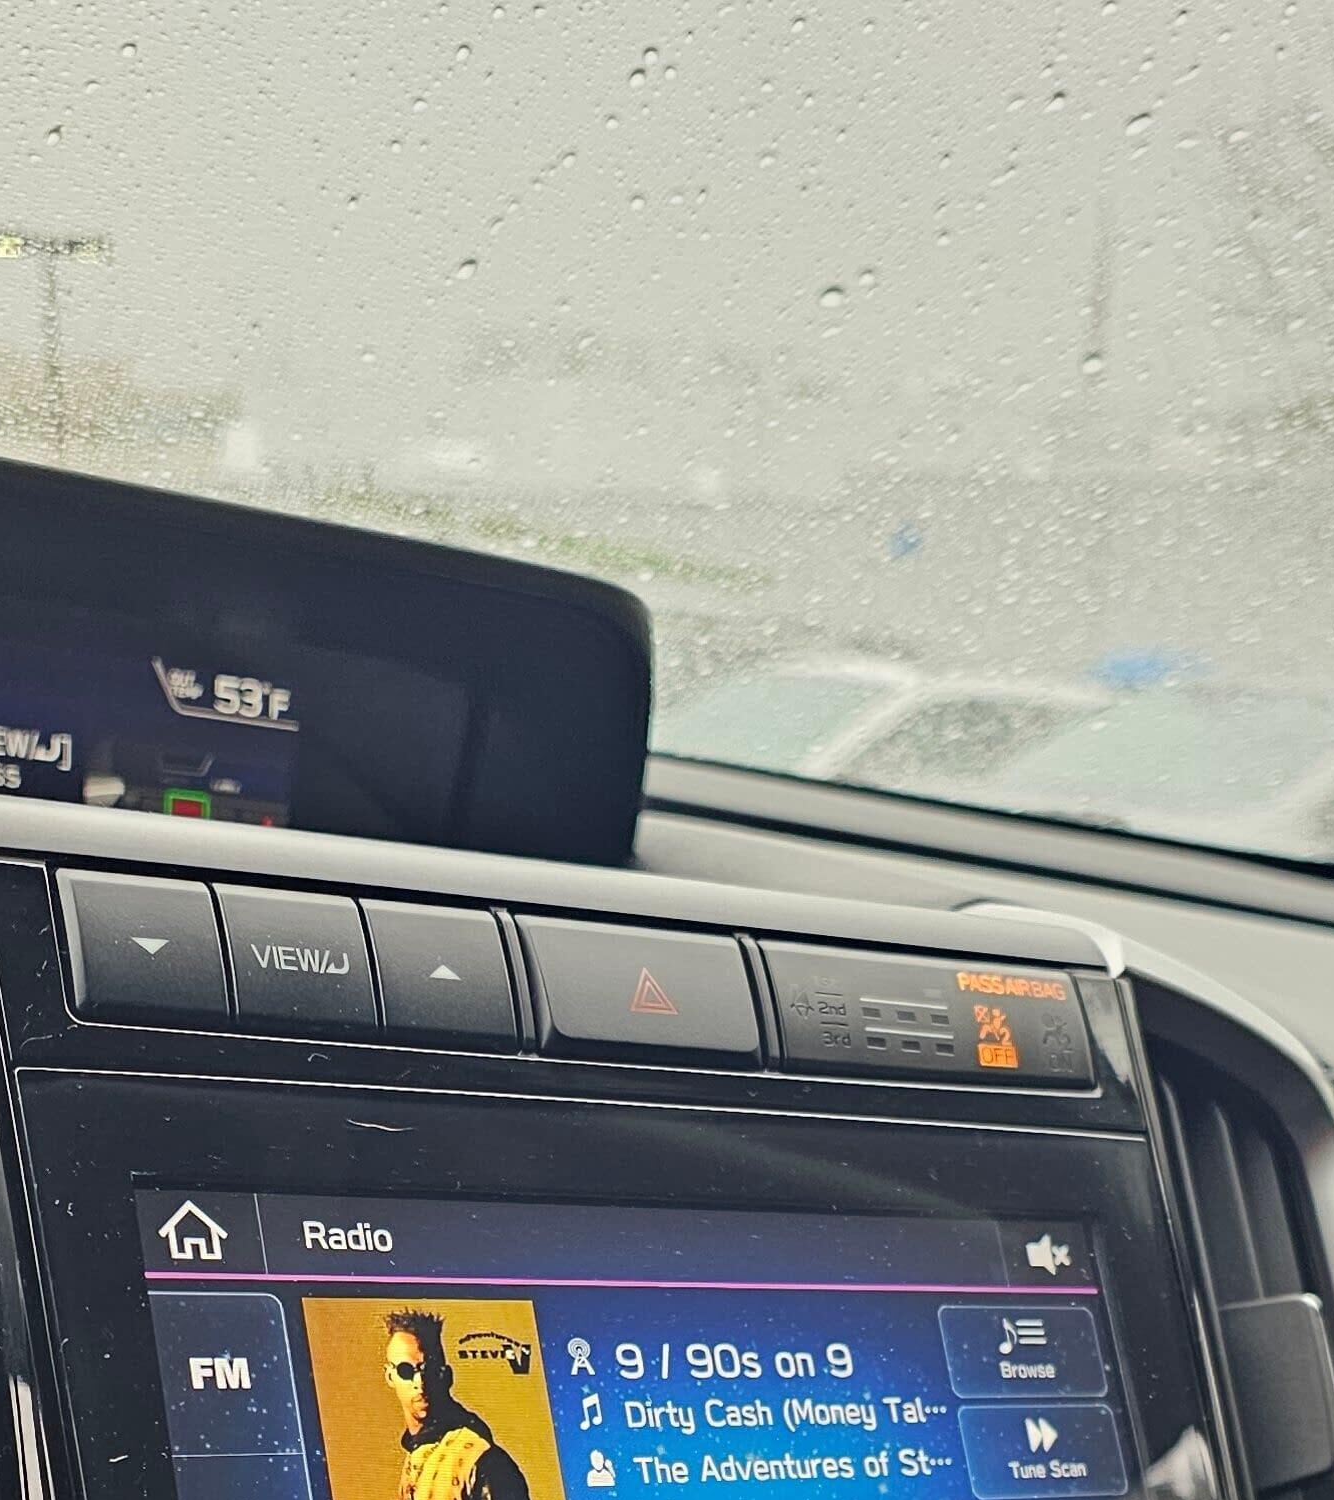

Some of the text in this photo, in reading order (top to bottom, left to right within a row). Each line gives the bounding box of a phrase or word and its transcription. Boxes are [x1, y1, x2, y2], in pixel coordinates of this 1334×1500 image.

[818, 1001, 847, 1017] 2nd
[823, 1032, 852, 1048] 3rd
[982, 1045, 1015, 1065] OFF
[302, 1220, 393, 1253] Radio
[188, 1357, 252, 1390] FM
[615, 1343, 644, 1380] 9
[685, 1343, 763, 1379] 90s
[774, 1351, 816, 1379] on
[825, 1343, 854, 1379] 9
[998, 1360, 1056, 1381] Browse
[624, 1398, 696, 1435] Dirty
[704, 1398, 774, 1427] Cash
[783, 1397, 878, 1433] (Money
[633, 1456, 689, 1486] The
[700, 1450, 855, 1484] Adventures
[864, 1450, 891, 1477] of
[1008, 1459, 1087, 1481] Tune Scan
